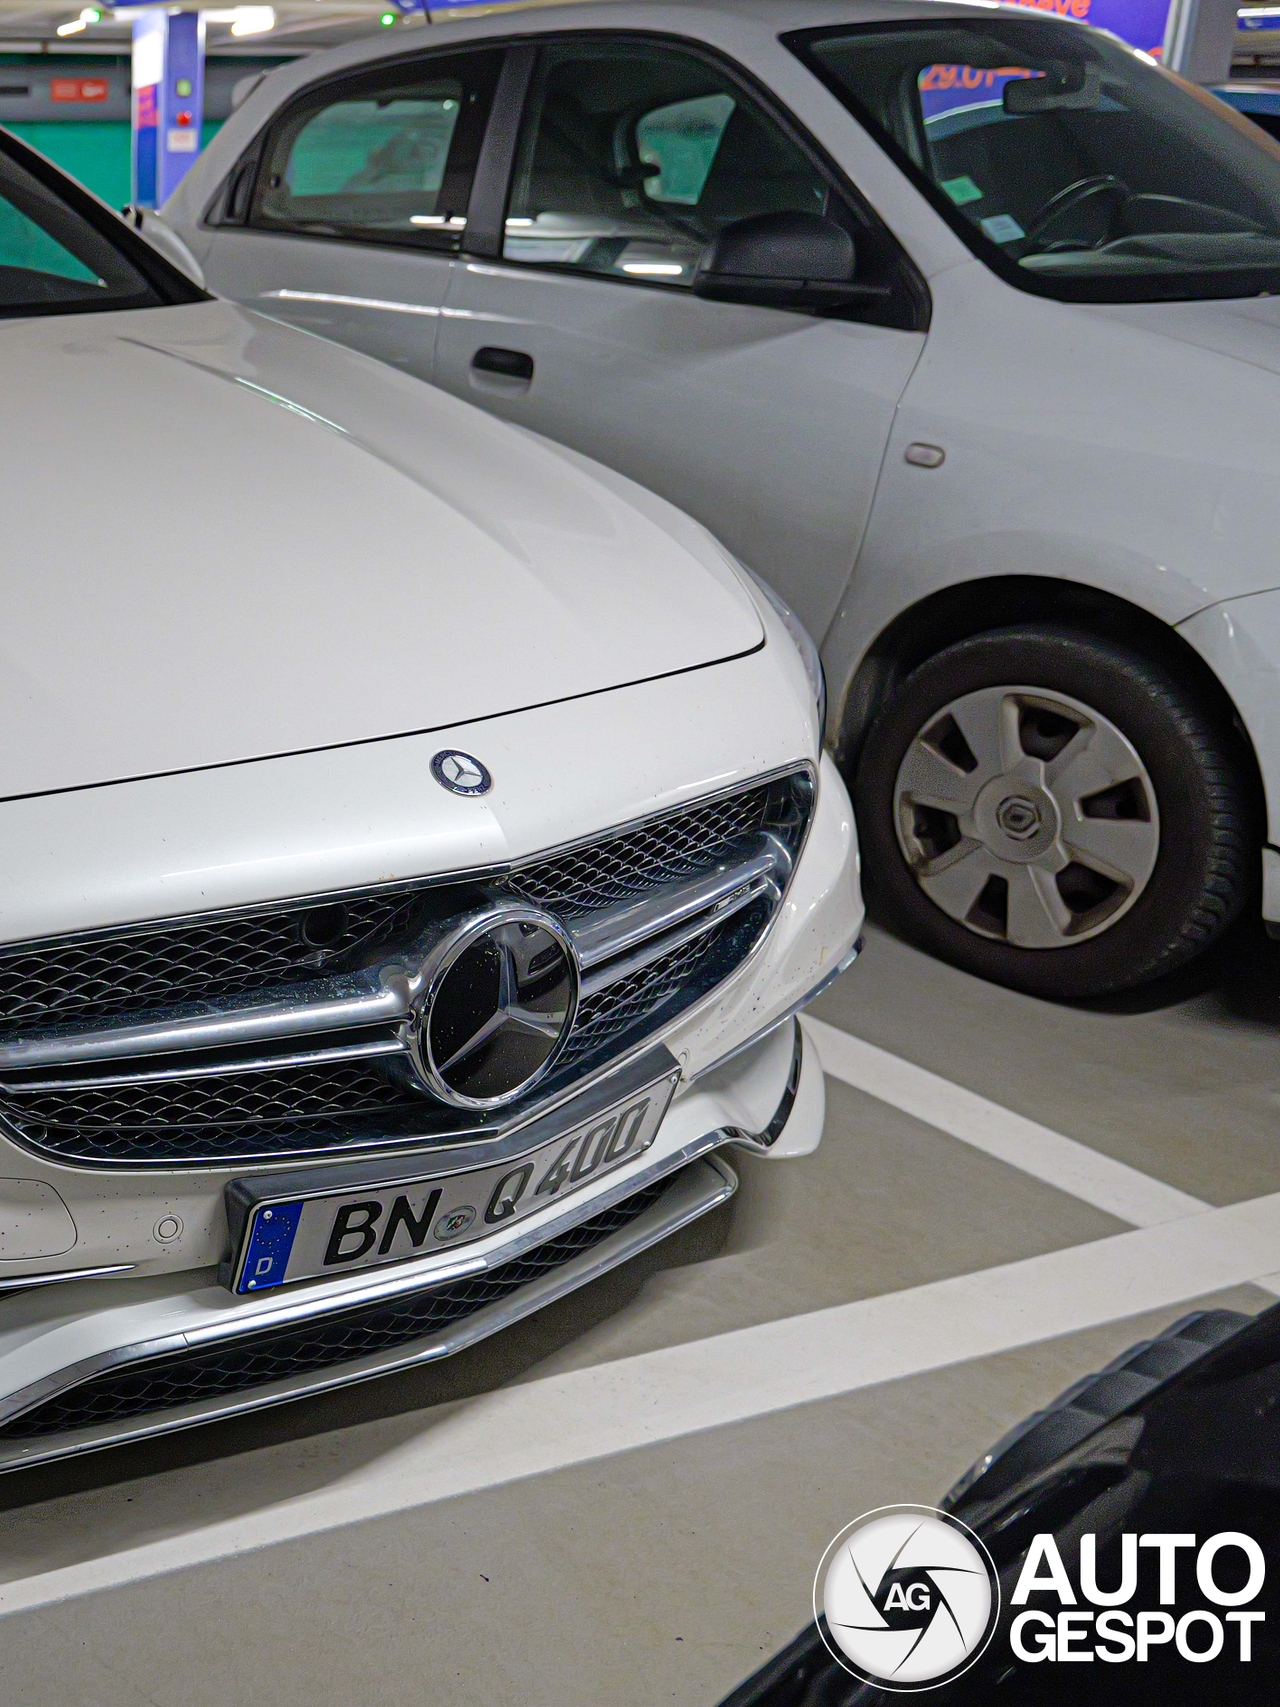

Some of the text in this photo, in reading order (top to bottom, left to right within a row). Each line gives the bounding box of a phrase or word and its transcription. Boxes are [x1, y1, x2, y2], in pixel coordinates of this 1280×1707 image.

[323, 1188, 444, 1266] BN
[484, 1162, 535, 1224] Q
[535, 1096, 651, 1196] 400
[255, 1257, 273, 1276] D
